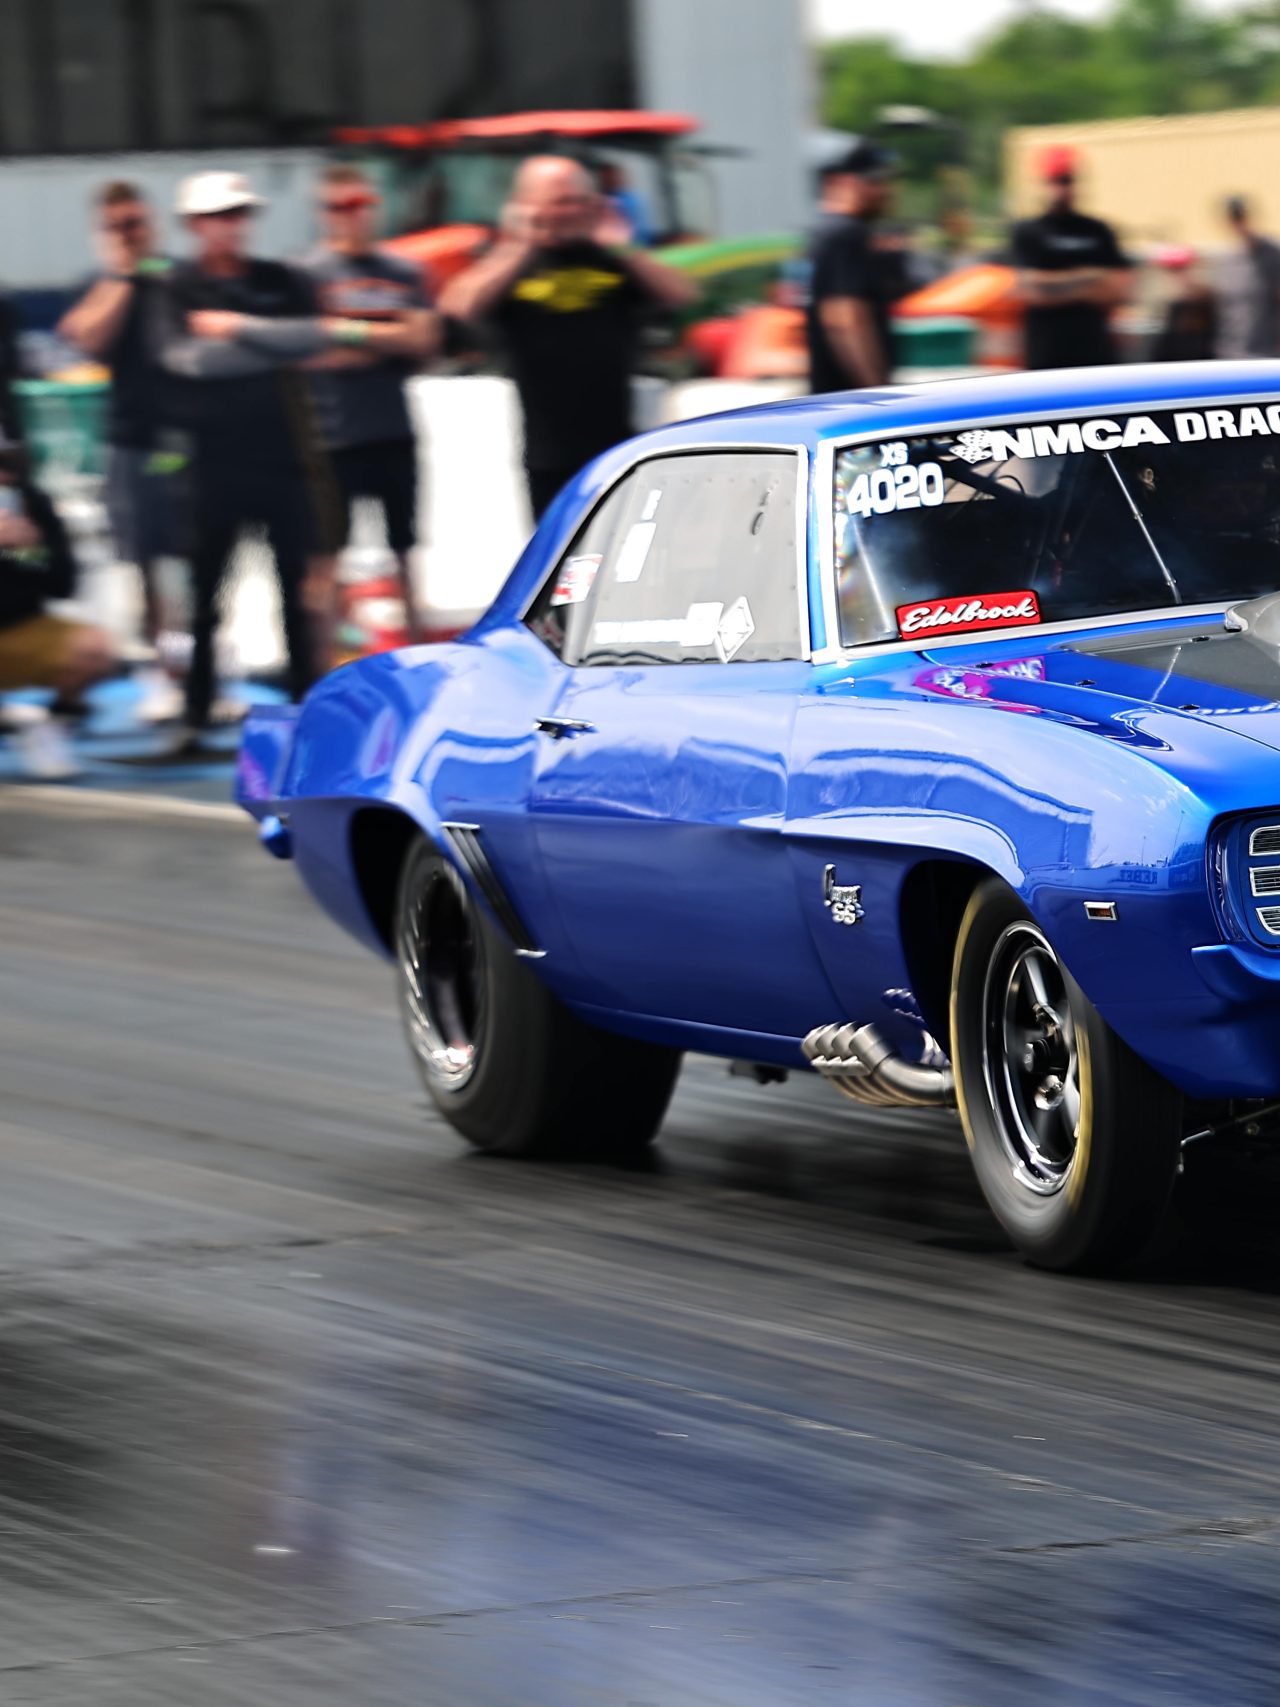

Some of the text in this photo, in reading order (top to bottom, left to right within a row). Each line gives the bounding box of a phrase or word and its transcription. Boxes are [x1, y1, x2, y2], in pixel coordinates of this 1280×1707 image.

[989, 417, 1171, 461] NMCA
[847, 461, 944, 519] 4020
[901, 598, 1036, 632] Edelbrock
